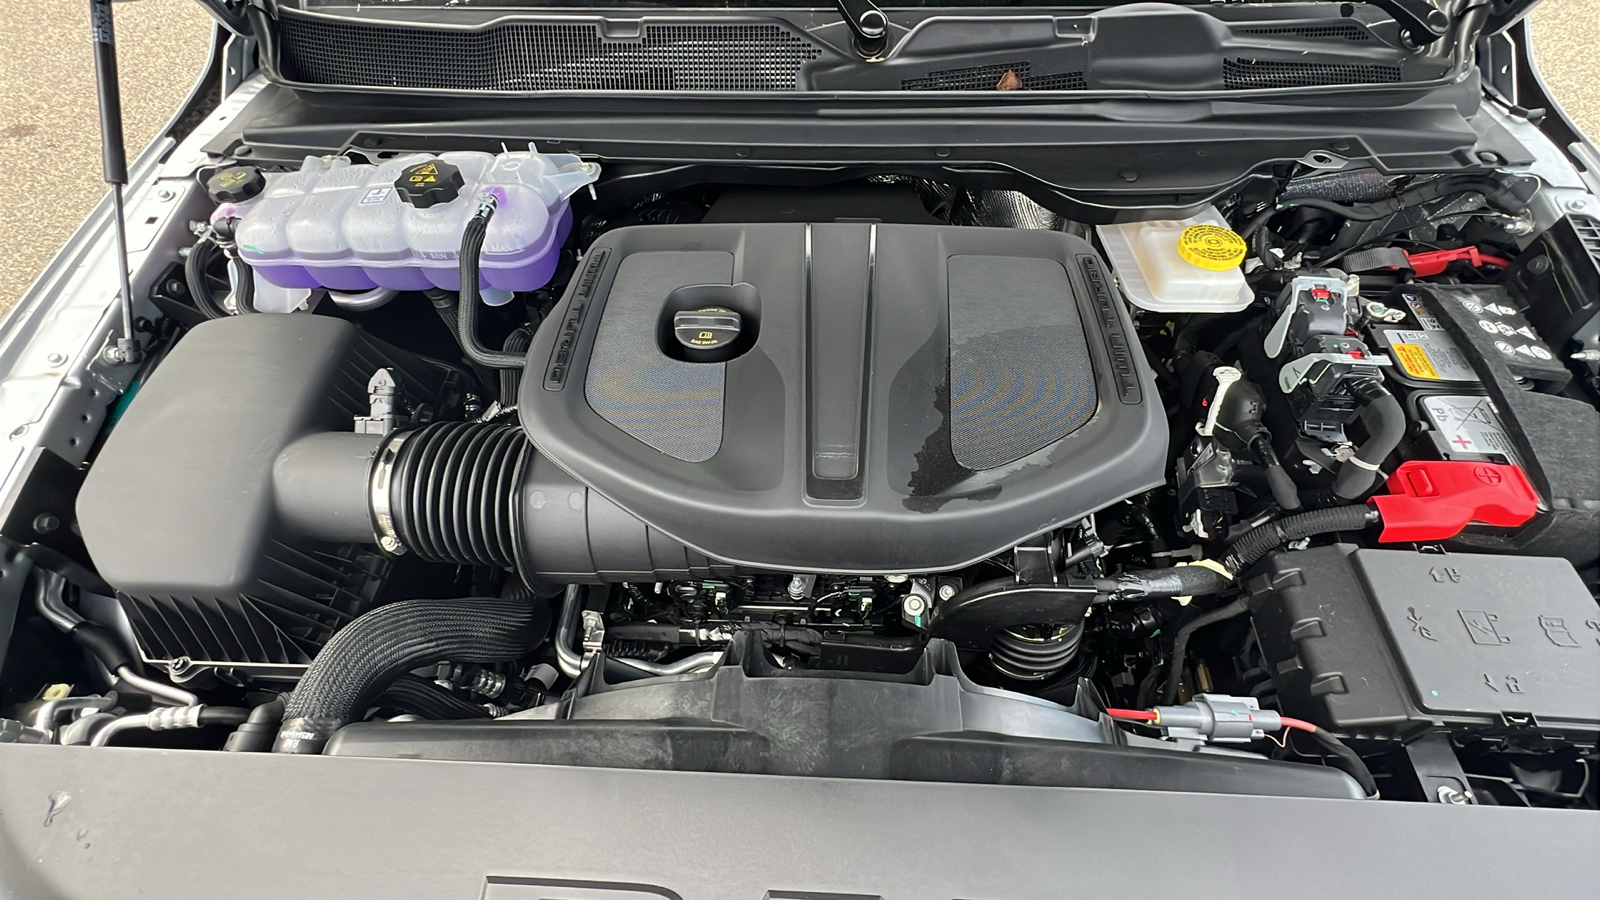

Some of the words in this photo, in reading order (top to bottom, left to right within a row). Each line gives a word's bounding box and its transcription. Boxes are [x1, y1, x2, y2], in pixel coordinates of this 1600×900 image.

[430, 252, 448, 260] MIN
[578, 250, 606, 300] TWIN
[1083, 256, 1115, 329] TURBO
[549, 303, 585, 384] TURBO
[1109, 333, 1135, 398] TWIN
[1432, 407, 1448, 422] Pb
